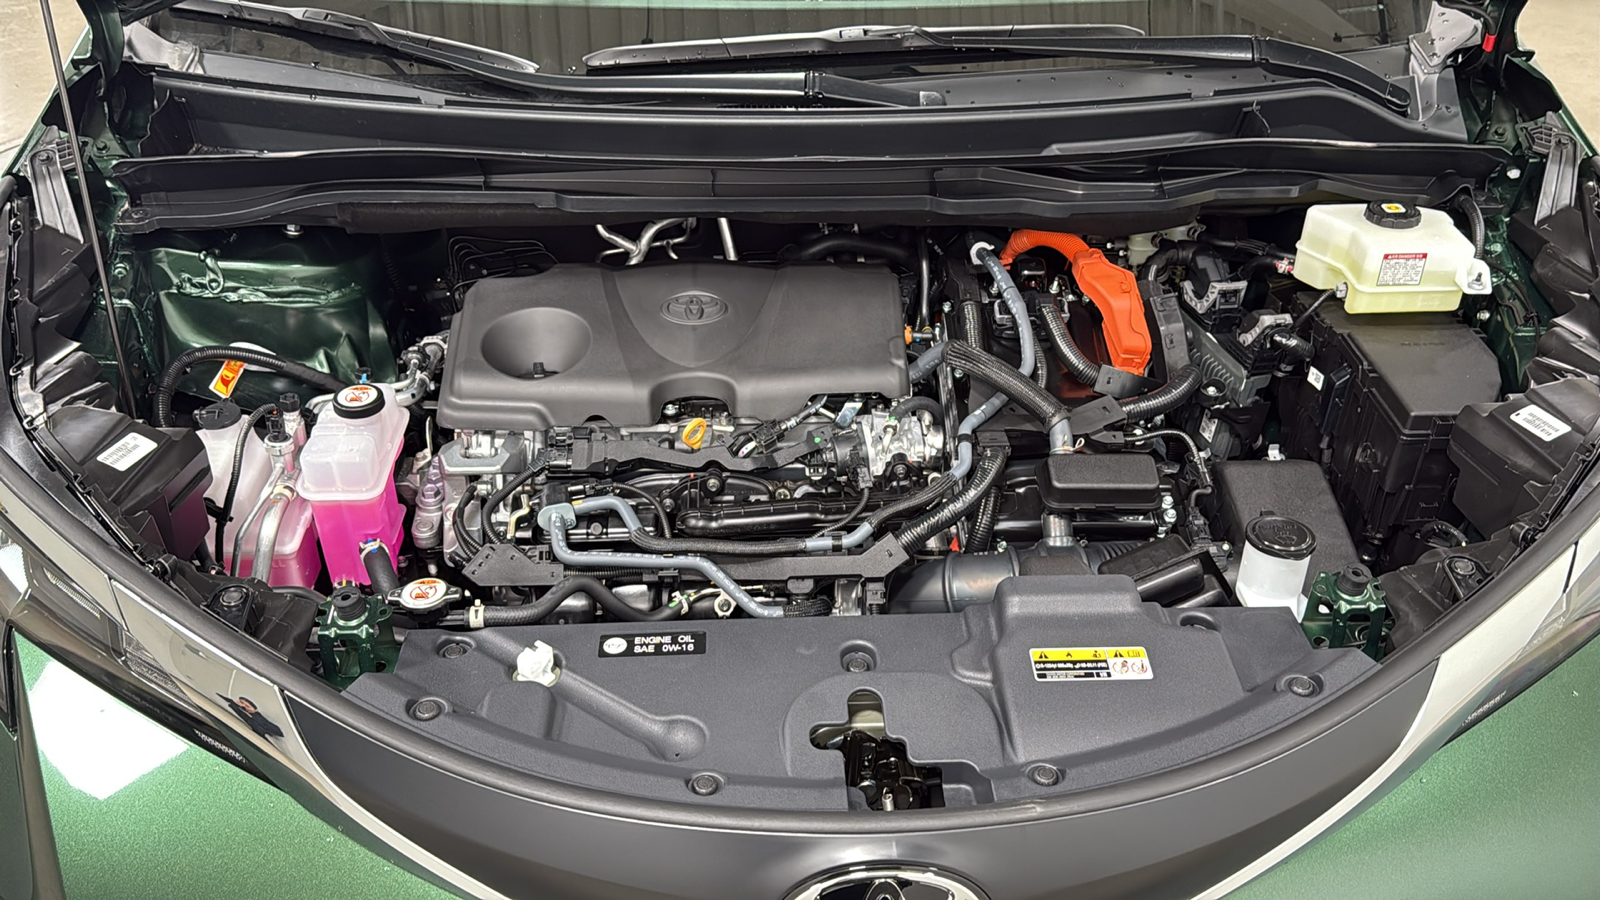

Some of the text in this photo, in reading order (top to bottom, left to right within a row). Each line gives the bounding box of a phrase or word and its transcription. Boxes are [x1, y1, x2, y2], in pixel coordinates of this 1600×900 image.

[634, 635, 695, 645] ENGINE OIL
[633, 643, 694, 653] SAE 0W-16
